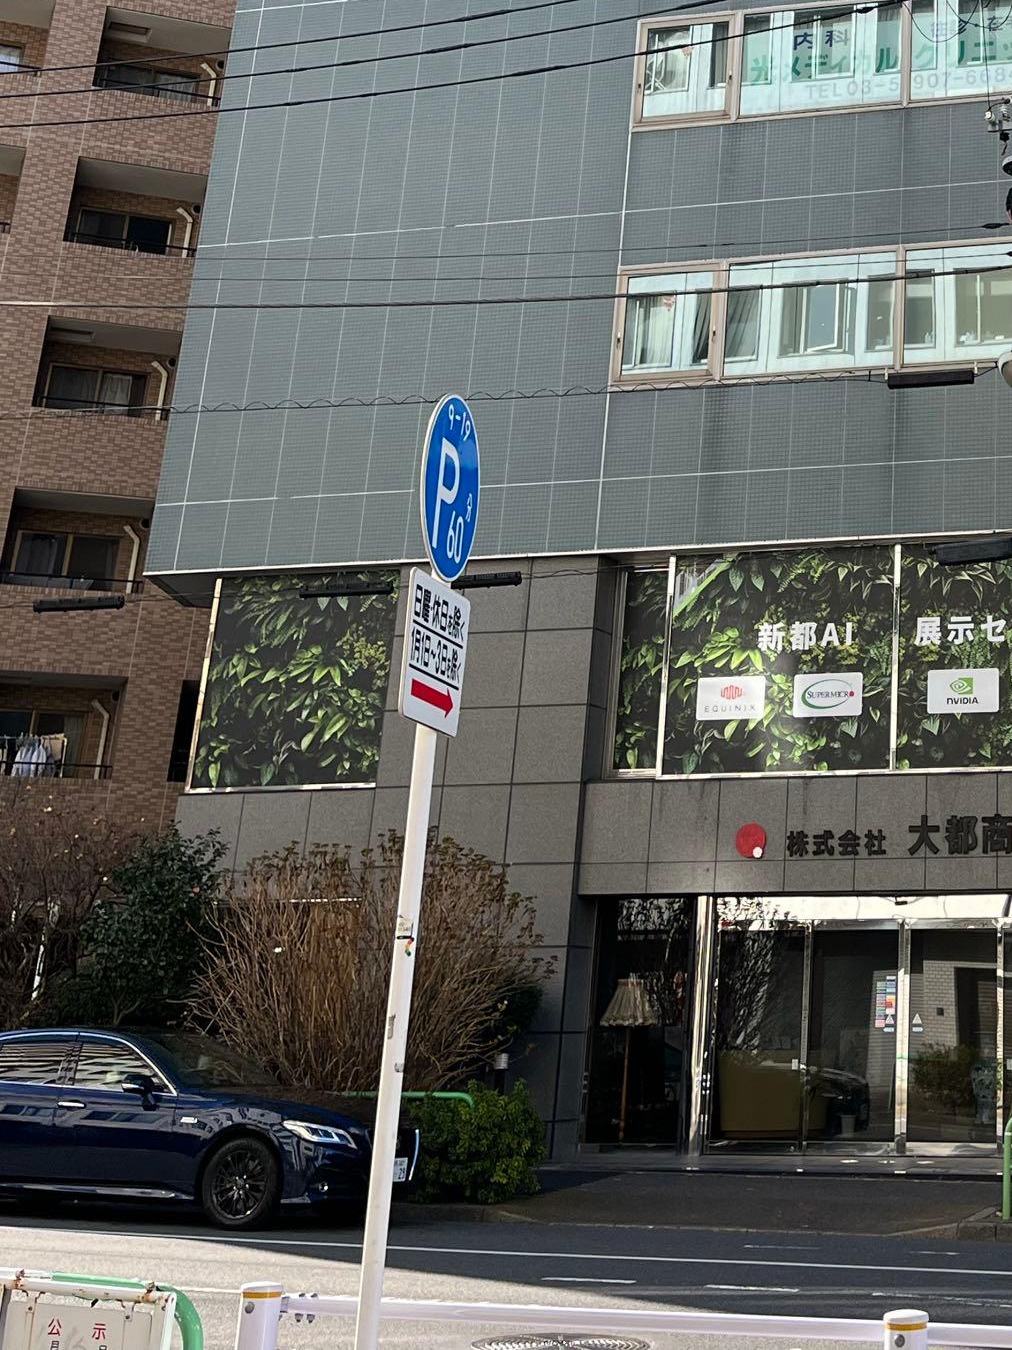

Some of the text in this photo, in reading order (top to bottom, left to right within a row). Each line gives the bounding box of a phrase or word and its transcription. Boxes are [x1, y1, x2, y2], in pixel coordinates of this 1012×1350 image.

[448, 403, 471, 442] 9-19
[431, 437, 460, 549] P
[413, 583, 465, 642] 日曜・休日を除く
[757, 620, 853, 651] 新都AI
[704, 704, 757, 713] EQUINIX
[946, 696, 979, 705] NVIDIA
[787, 829, 887, 858] 株式会社
